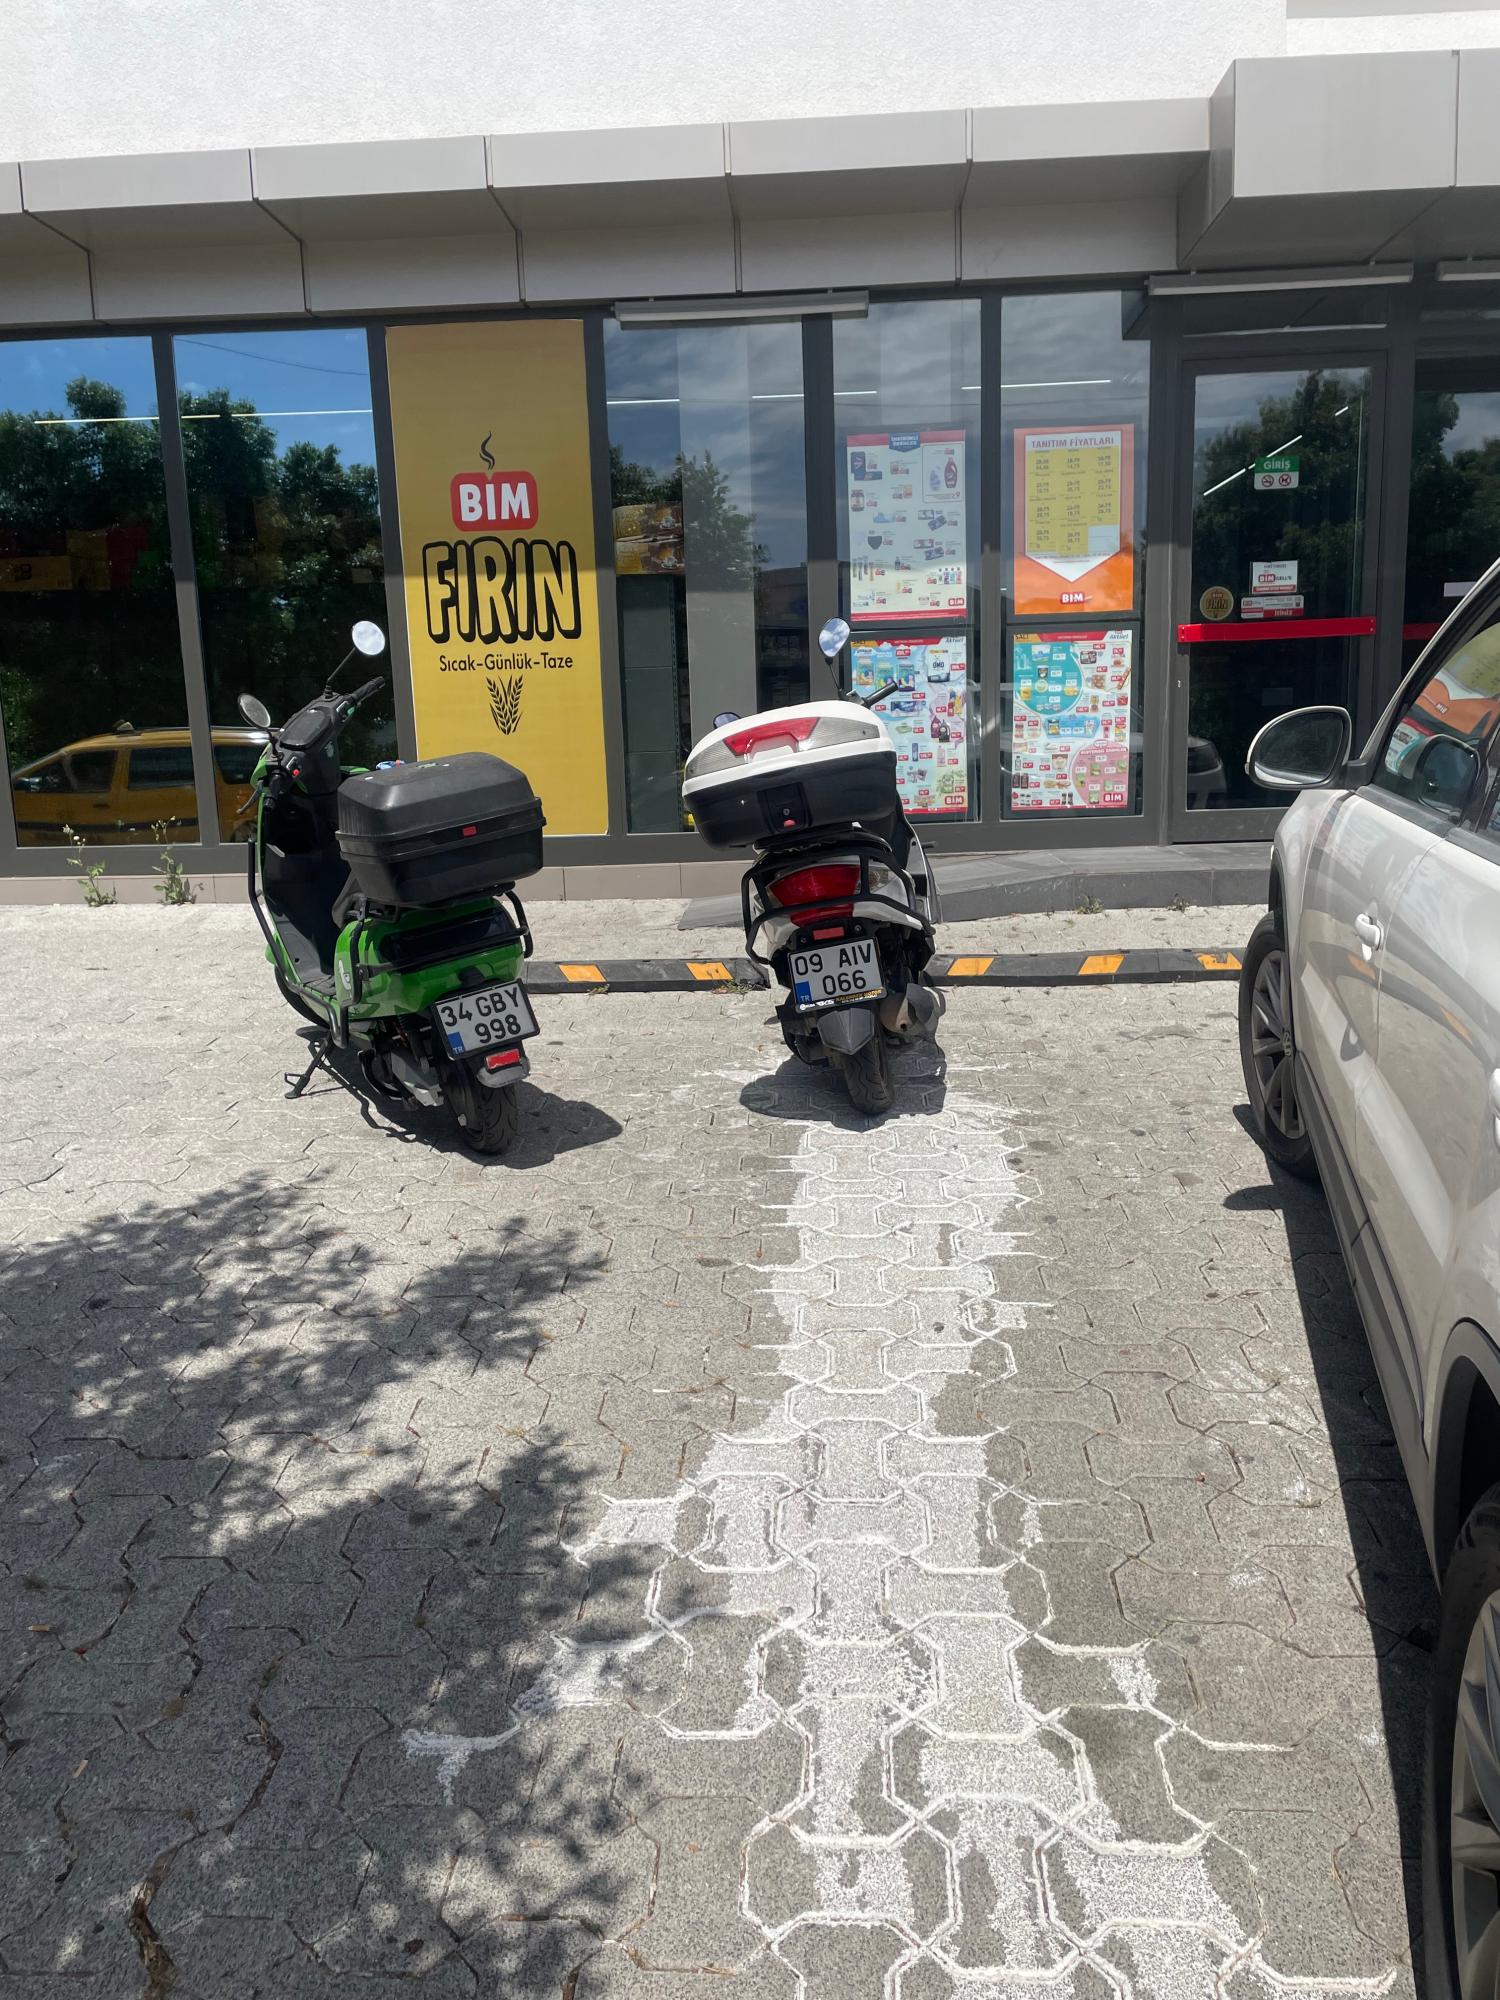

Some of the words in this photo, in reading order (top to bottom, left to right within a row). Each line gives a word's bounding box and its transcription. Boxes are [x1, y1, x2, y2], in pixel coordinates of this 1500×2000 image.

[1031, 439, 1067, 449] TANITIM
[1263, 457, 1291, 470] GİRİŞ
[422, 536, 582, 644] FIRIN
[439, 652, 573, 672] Sıcak-Günlük-Taze
[932, 661, 945, 669] OMO
[794, 953, 824, 976] 09
[839, 943, 871, 968] AIV
[822, 969, 867, 995] 066
[441, 1002, 473, 1027] 34
[475, 987, 518, 1017] GBY
[474, 1014, 521, 1044] 998
[453, 1045, 464, 1055] TR
